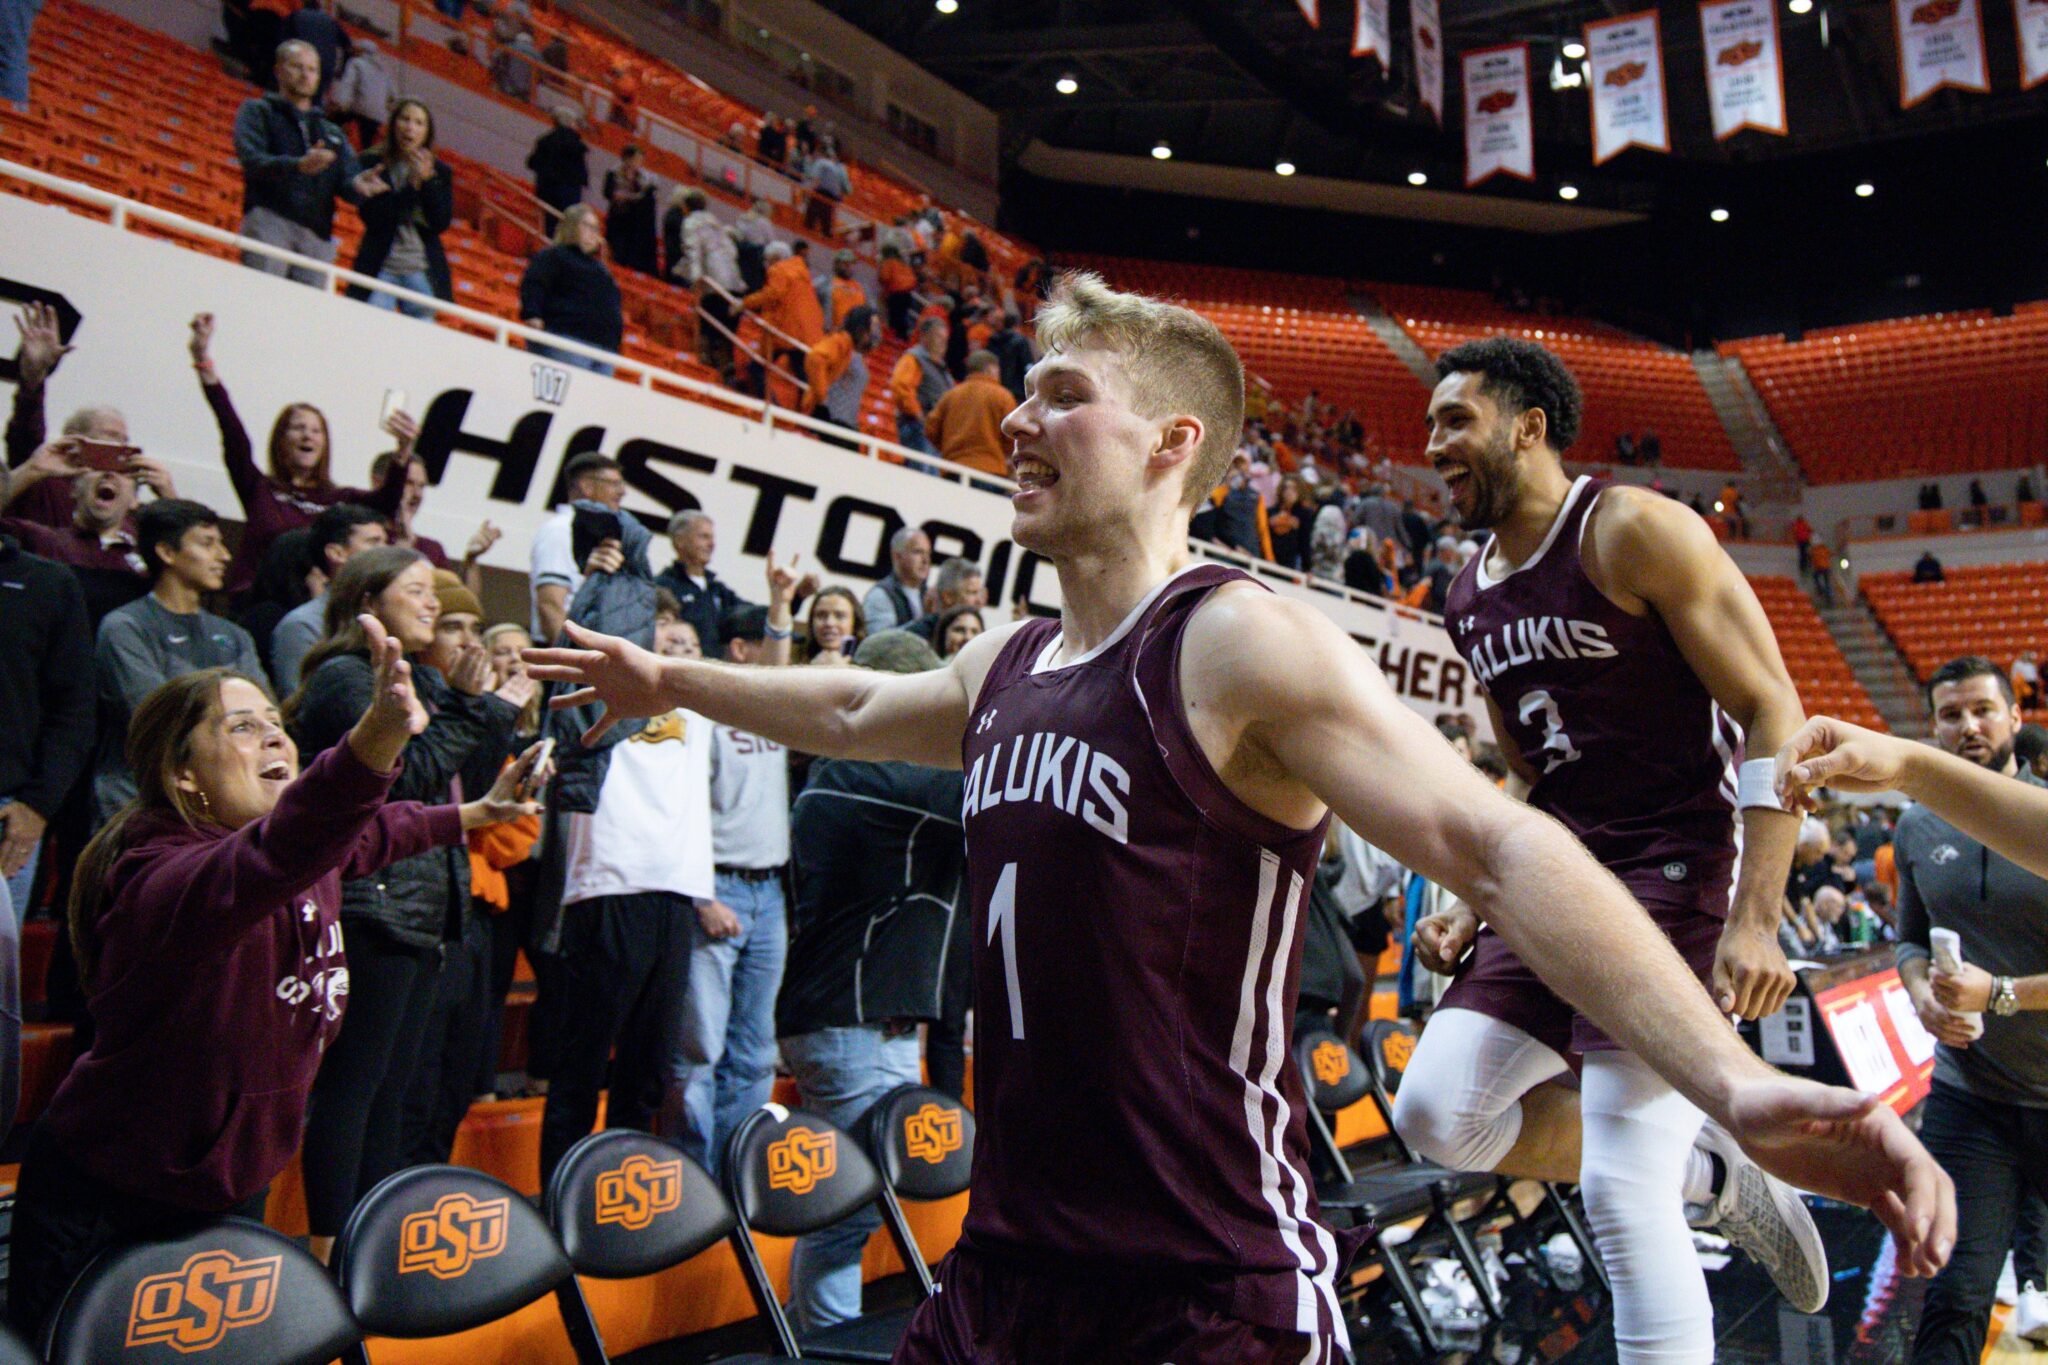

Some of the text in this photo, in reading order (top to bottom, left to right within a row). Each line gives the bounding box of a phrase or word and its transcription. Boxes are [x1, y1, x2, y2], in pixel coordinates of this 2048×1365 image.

[530, 362, 571, 405] 107
[1468, 616, 1620, 692] ALUKIS
[961, 732, 1131, 857] ALUKIS
[987, 862, 1025, 1040] 1
[767, 1126, 837, 1195] OSU
[905, 1103, 963, 1164] OSU
[595, 1154, 682, 1231] OSU
[399, 1192, 510, 1280] OSU
[125, 1249, 283, 1354] OSU
